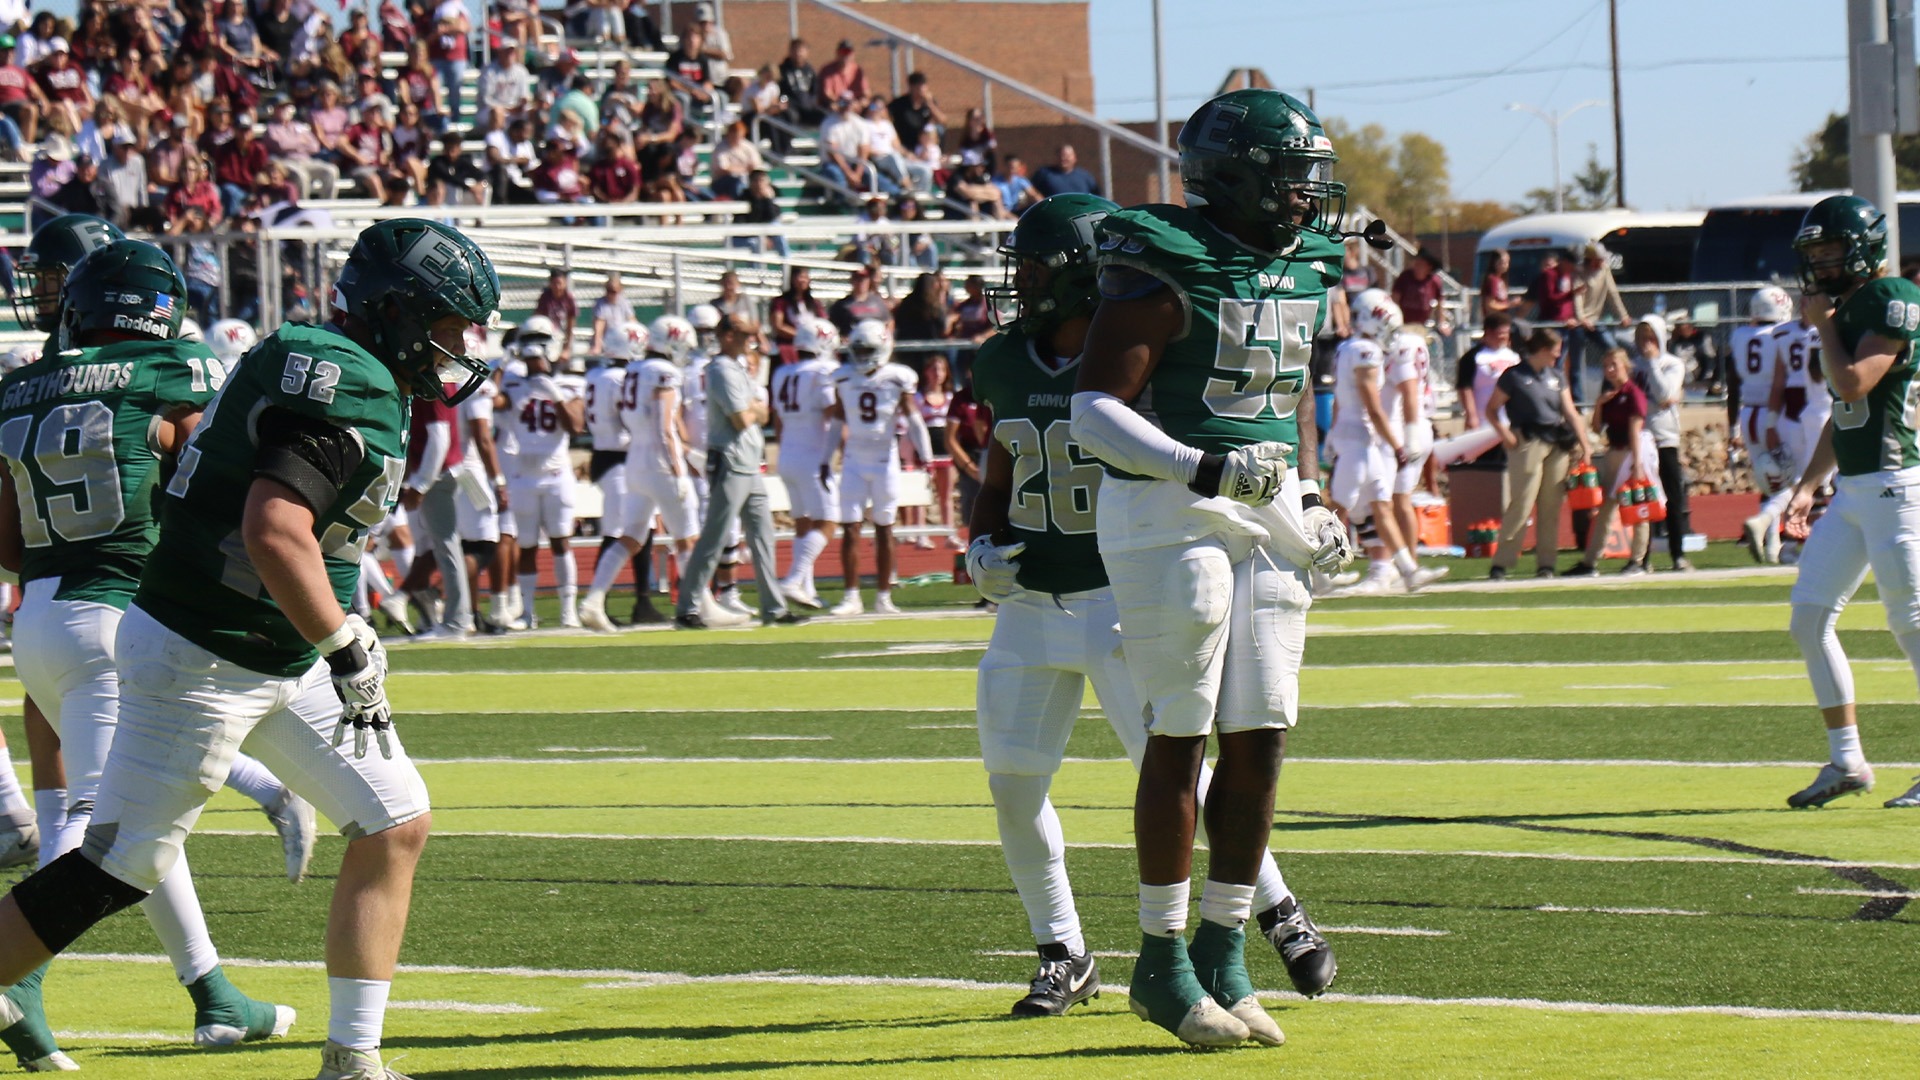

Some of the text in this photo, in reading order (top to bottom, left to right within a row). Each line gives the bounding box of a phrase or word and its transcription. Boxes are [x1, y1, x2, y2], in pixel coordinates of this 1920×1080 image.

[1196, 101, 1249, 153] E
[394, 225, 464, 291] E
[1258, 273, 1295, 289] ENMU
[113, 314, 169, 339] Riddell
[1202, 298, 1319, 419] 55
[1747, 338, 1762, 374] 6
[1789, 342, 1804, 371] 6
[2, 361, 134, 411] GREYHOUNDS
[187, 358, 227, 392] 19
[281, 352, 341, 404] 52
[779, 374, 800, 412] 41
[520, 397, 557, 433] 46
[859, 391, 877, 423] 9
[1028, 394, 1071, 408] ENMU
[0, 400, 125, 548] 19
[994, 418, 1106, 535] 26
